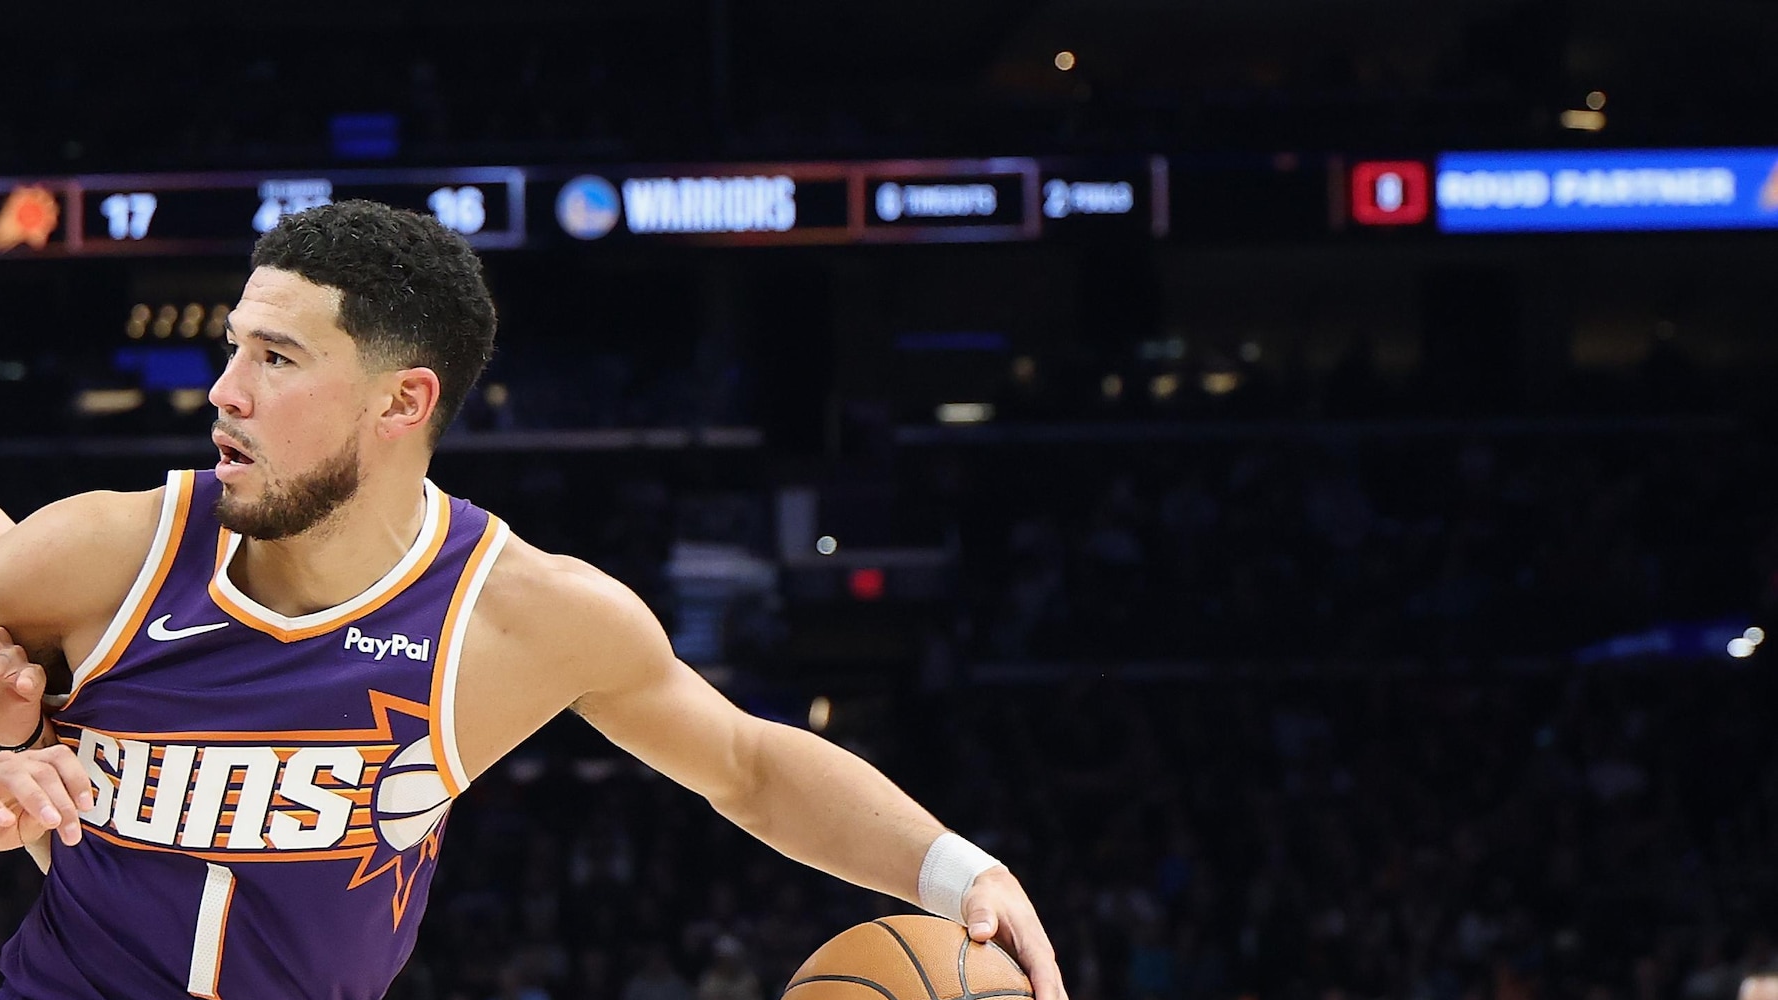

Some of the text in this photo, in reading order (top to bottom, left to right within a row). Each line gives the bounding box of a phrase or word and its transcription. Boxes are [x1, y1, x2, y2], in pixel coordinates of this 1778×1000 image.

[622, 176, 796, 234] WARRIORS
[1551, 166, 1736, 208] PARTNER
[101, 192, 157, 240] 17
[344, 627, 431, 662] PayPal
